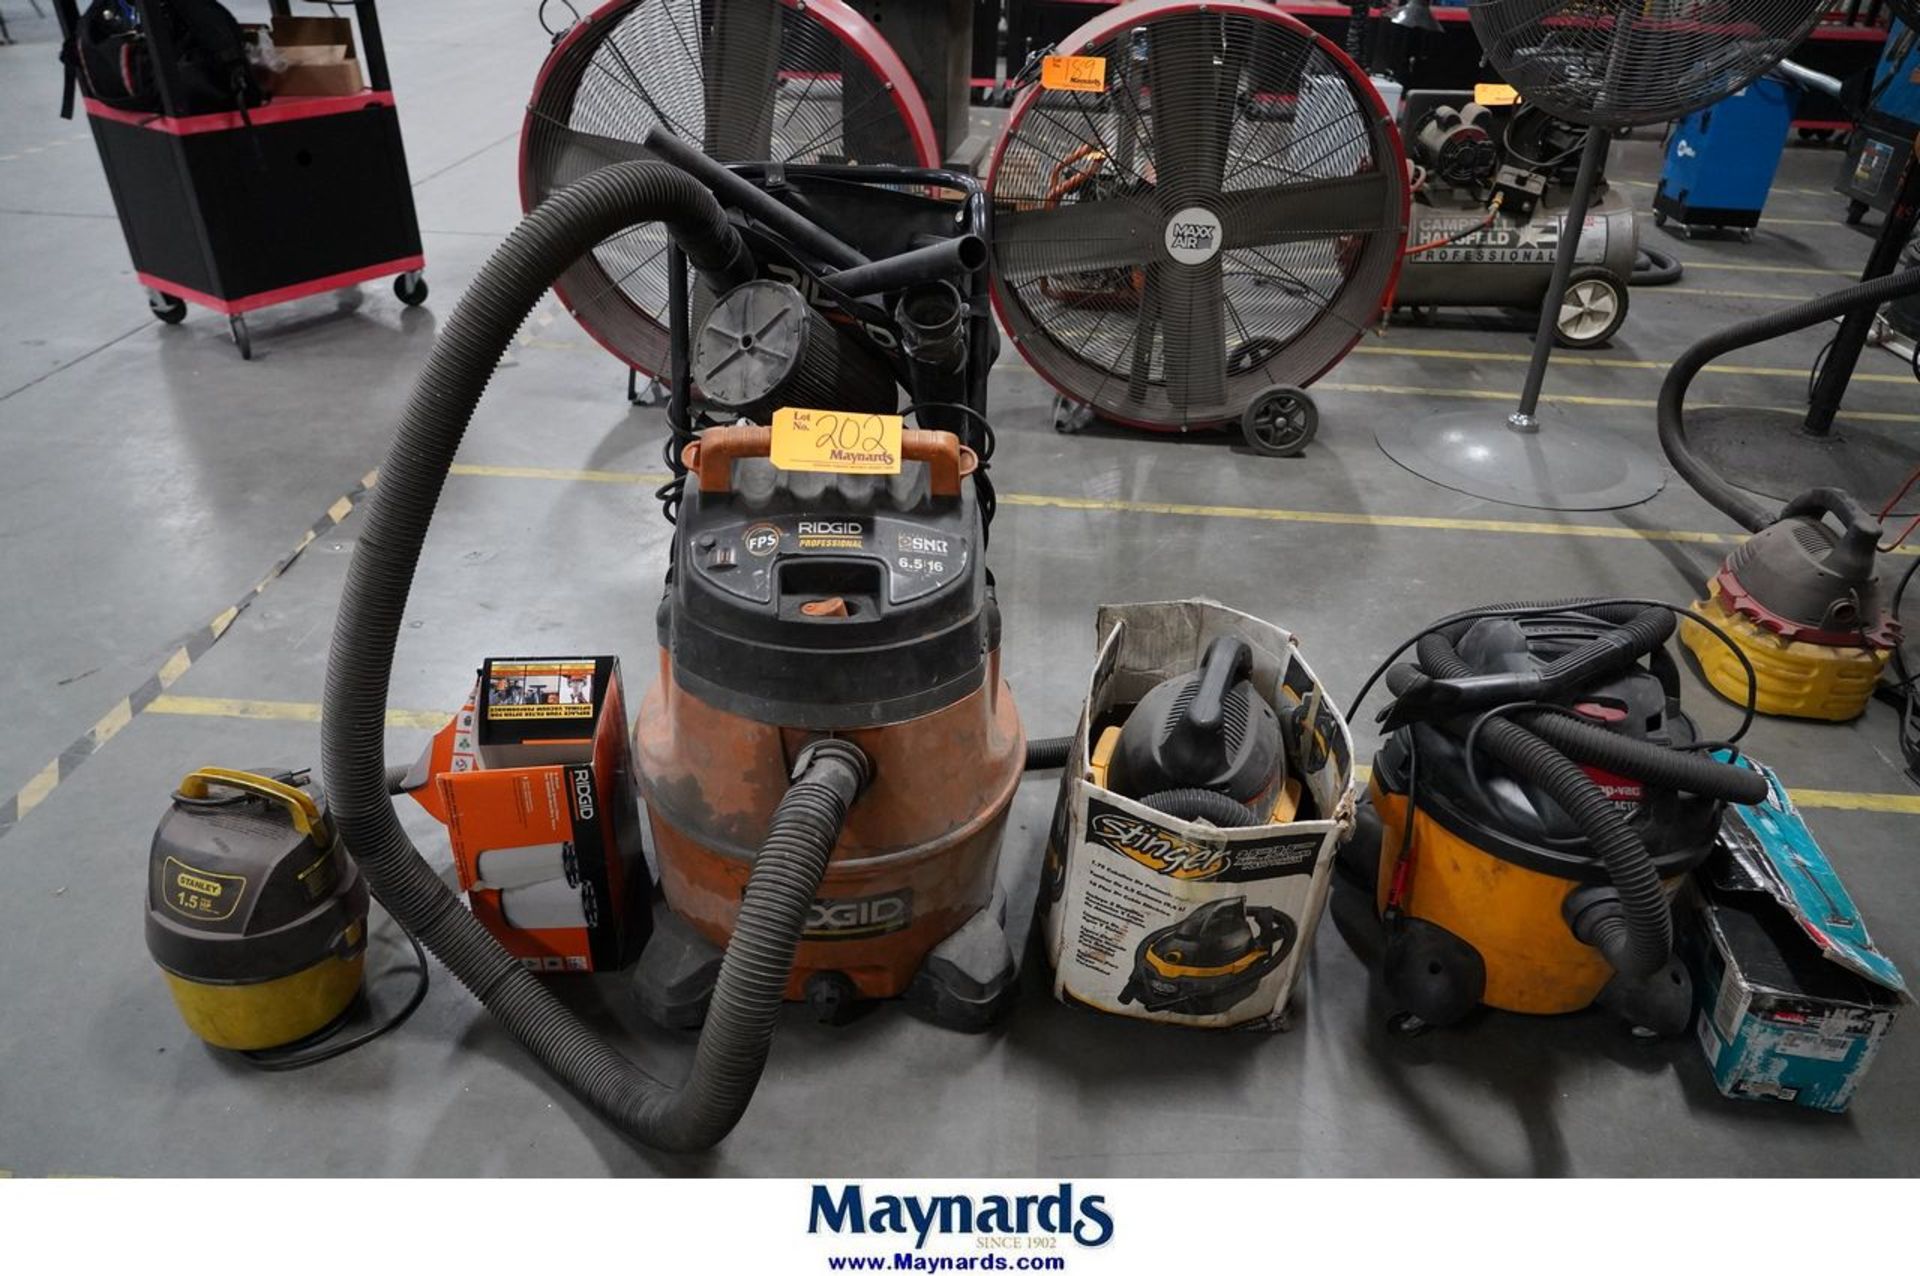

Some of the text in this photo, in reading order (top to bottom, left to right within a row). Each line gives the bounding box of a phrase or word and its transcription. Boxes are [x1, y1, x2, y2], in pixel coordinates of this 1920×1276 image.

[1173, 223, 1215, 239] MAXX
[1171, 237, 1198, 249] AIR
[1414, 250, 1556, 262] PROFESSIONAL
[794, 412, 811, 424] Lot
[793, 421, 810, 434] No.
[815, 414, 888, 453] 202
[829, 449, 895, 465] Maynards
[798, 522, 863, 534] RIDGID
[749, 534, 777, 550] FPS
[799, 539, 863, 549] PROFESSIONAL
[574, 769, 595, 820] RIDGID
[1102, 816, 1231, 872] Stinger
[180, 875, 219, 893] STANLEY
[177, 892, 199, 909] 1.5
[806, 897, 905, 927] DGID
